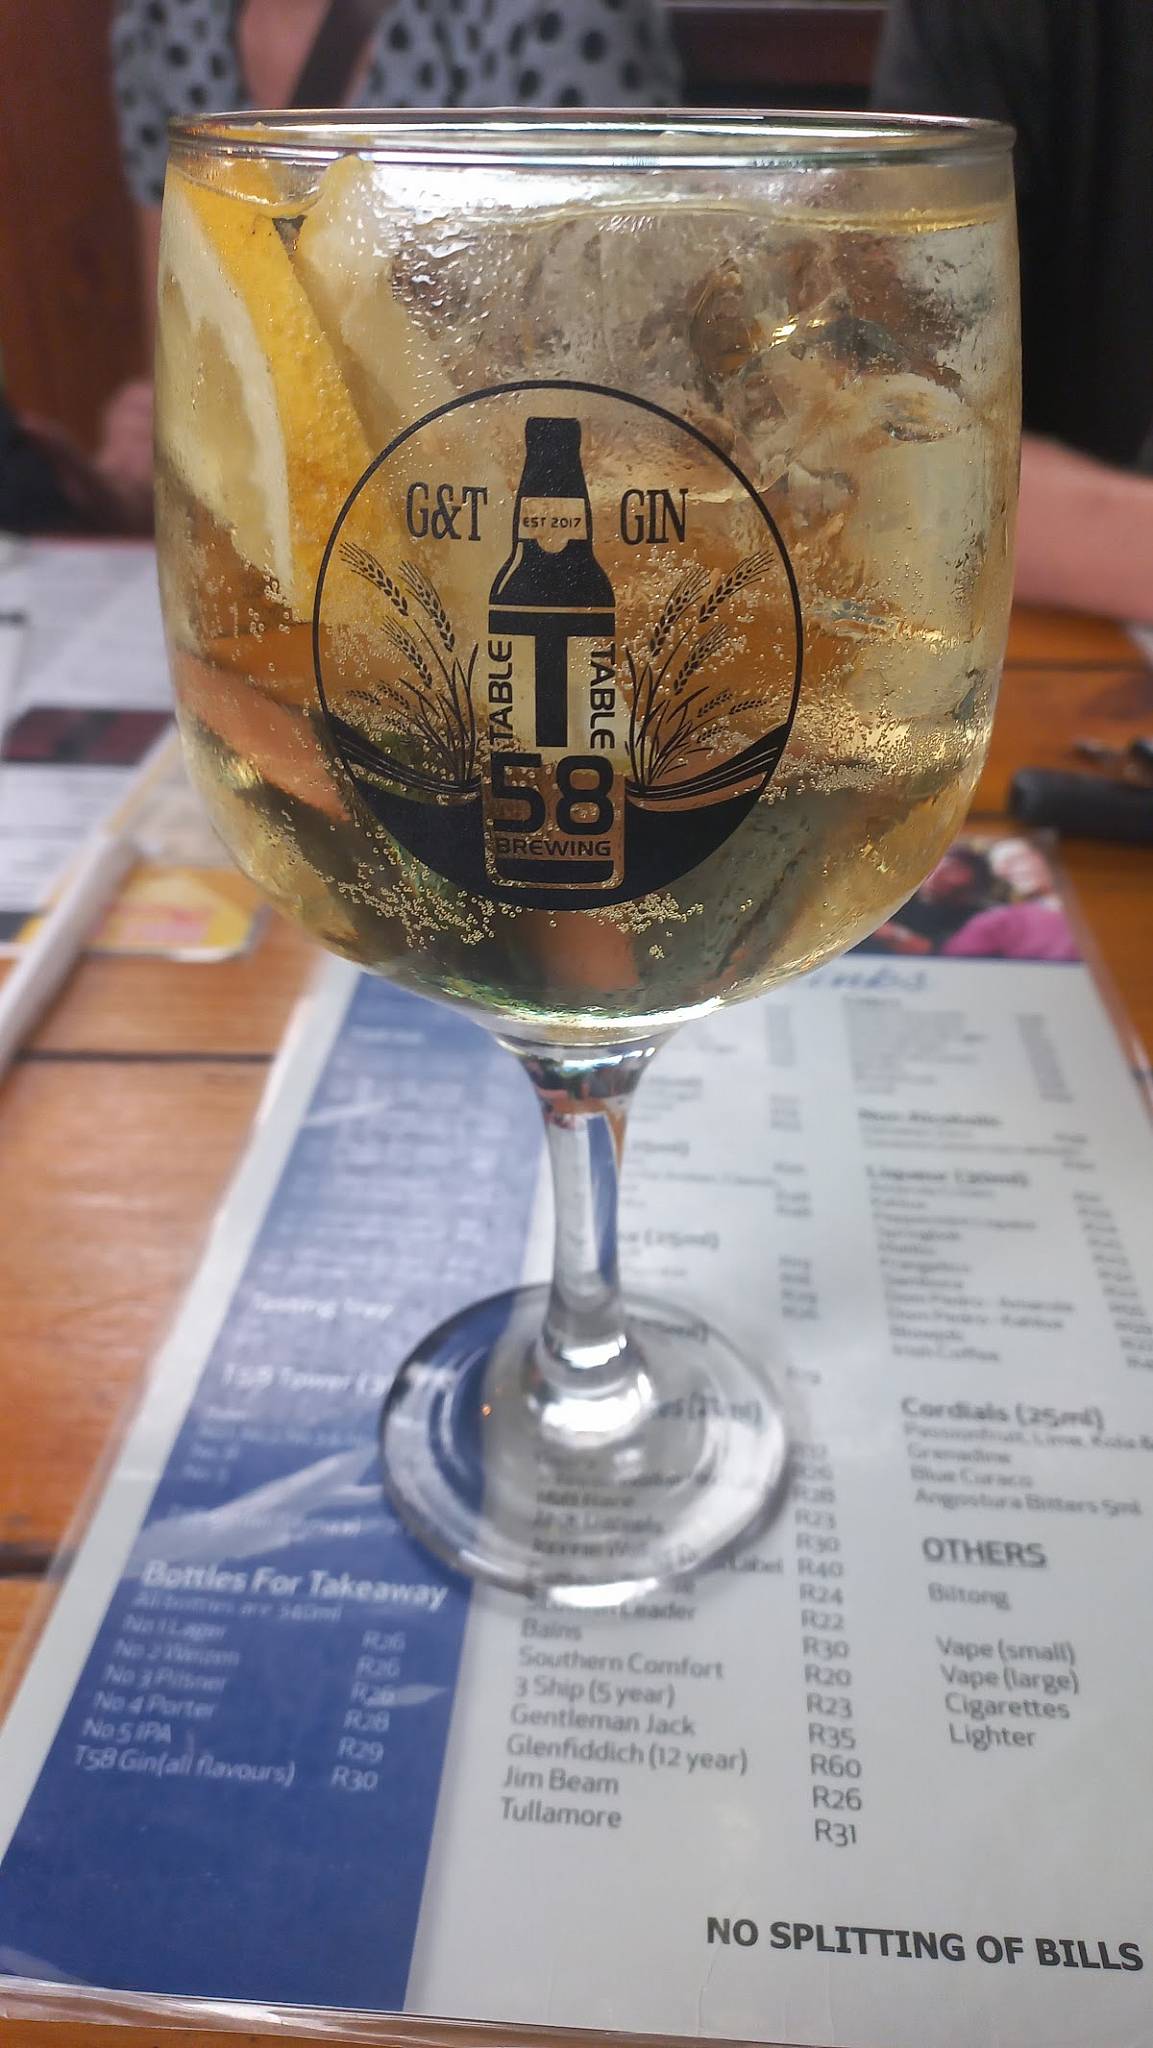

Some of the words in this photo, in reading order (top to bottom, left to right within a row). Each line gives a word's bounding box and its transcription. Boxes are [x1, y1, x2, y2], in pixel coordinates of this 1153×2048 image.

[406, 481, 488, 541] G&T
[522, 517, 547, 529] EST
[550, 517, 582, 530] 2017
[620, 488, 689, 546] GIN
[488, 639, 513, 744] TABLE
[589, 643, 616, 750] TABLE
[491, 752, 614, 835] 58
[497, 838, 611, 856] BREWING
[922, 1536, 1047, 1568] OTHERS
[144, 1558, 246, 1594] Bottles
[251, 1565, 301, 1598] For
[309, 1569, 448, 1614] Takeaway
[800, 1583, 845, 1605] R24
[521, 1616, 583, 1641] Bains
[801, 1608, 845, 1631] R22
[519, 1645, 624, 1672] Southern
[627, 1651, 725, 1679] Comfort
[803, 1635, 850, 1660] R30
[937, 1635, 994, 1659] Vape
[998, 1638, 1076, 1665] (small)
[804, 1663, 852, 1687] R20
[941, 1663, 999, 1688] Vape
[1003, 1667, 1080, 1695] (large)
[147, 1693, 216, 1719] Porter
[514, 1675, 529, 1698] 3
[534, 1674, 584, 1702] Ship
[588, 1679, 612, 1704] (5
[616, 1682, 676, 1709] year)
[806, 1692, 853, 1718] R23
[945, 1691, 1071, 1720] Cigarettes
[82, 1717, 115, 1739] No
[135, 1720, 172, 1744] IPA
[510, 1702, 640, 1733] Gentleman
[646, 1713, 696, 1736] Jack
[337, 1736, 384, 1765] R29
[808, 1722, 856, 1750] R35
[949, 1722, 1037, 1751] Lighter
[506, 1733, 645, 1765] Glenfiddich
[649, 1742, 681, 1771] (12
[686, 1747, 748, 1776] year)
[810, 1753, 862, 1780] R60
[196, 1752, 296, 1788] flavours)
[330, 1765, 379, 1792] R30
[502, 1765, 544, 1789] Jim
[549, 1767, 620, 1795] Beam
[501, 1796, 623, 1829] Tullamore
[812, 1784, 862, 1812] R26
[814, 1817, 857, 1848] R31
[706, 1916, 759, 1948] NO
[770, 1921, 967, 1962] SPLITTING
[976, 1935, 1024, 1965] OF
[1037, 1938, 1145, 1972] BILLS
